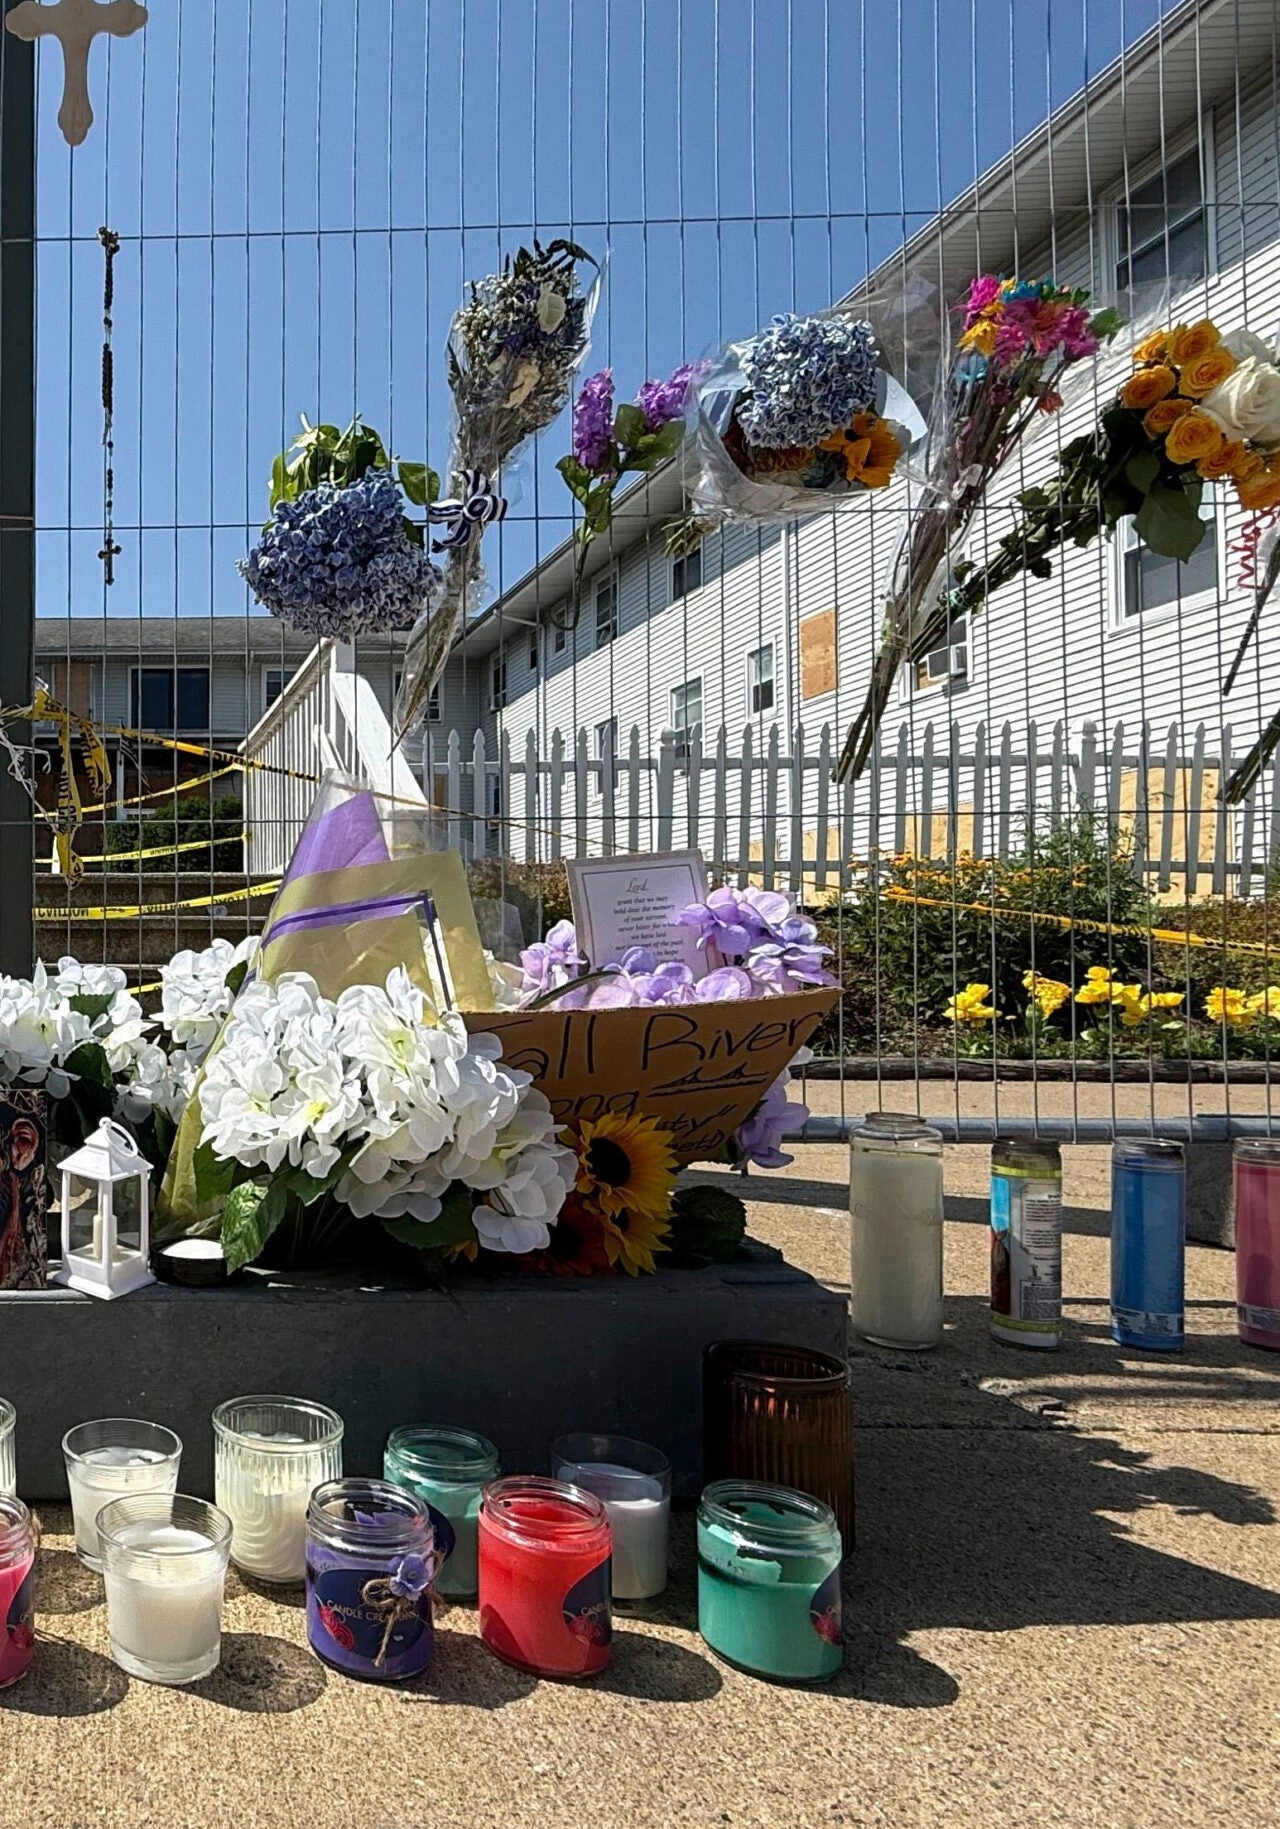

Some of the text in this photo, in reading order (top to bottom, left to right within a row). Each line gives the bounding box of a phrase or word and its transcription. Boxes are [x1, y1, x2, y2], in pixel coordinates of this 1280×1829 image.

[470, 1010, 825, 1080] all River
[326, 1599, 363, 1620] CANDLE
